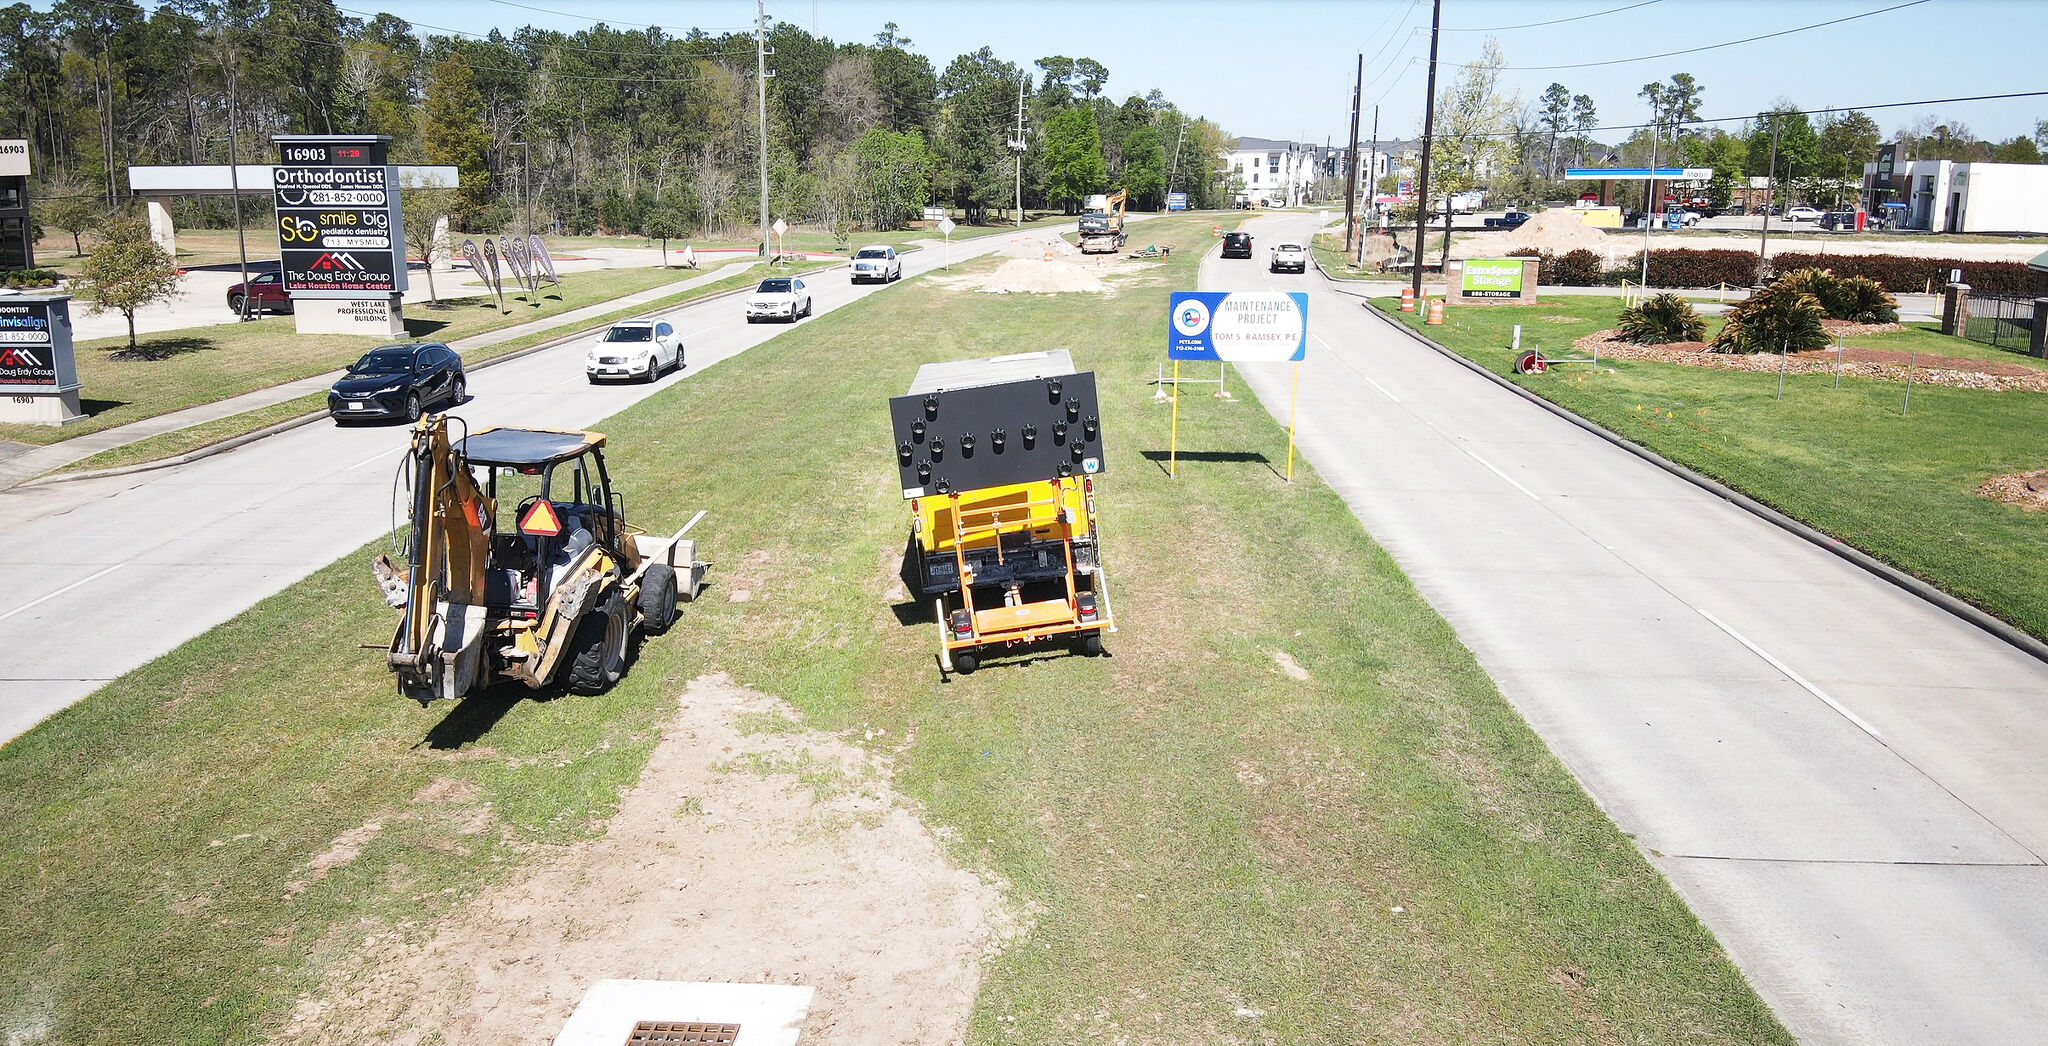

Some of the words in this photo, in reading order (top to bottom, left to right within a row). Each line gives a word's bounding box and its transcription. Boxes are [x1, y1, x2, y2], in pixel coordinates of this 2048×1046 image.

[0, 145, 24, 153] 16903
[286, 148, 326, 160] 16903
[275, 168, 384, 183] Orthodontist
[312, 192, 383, 202] 281-852-0000
[320, 211, 357, 226] smile
[362, 210, 388, 229] big
[320, 228, 353, 236] pediatric
[354, 228, 388, 236] dentistry
[287, 270, 306, 281] The
[307, 271, 333, 282] Doug
[334, 271, 356, 282] Erdy
[358, 271, 390, 283] Group
[1473, 275, 1512, 287] Storage
[1224, 301, 1291, 312] MAINTENANCE
[0, 316, 47, 330] invisalign
[1238, 313, 1278, 324] PROJECT
[1215, 333, 1234, 341] TOM
[1245, 333, 1283, 342] RAMSEY,
[1285, 333, 1299, 341] P.E.
[17, 368, 32, 377] Erdy
[33, 368, 55, 376] Group
[12, 396, 34, 404] 16903
